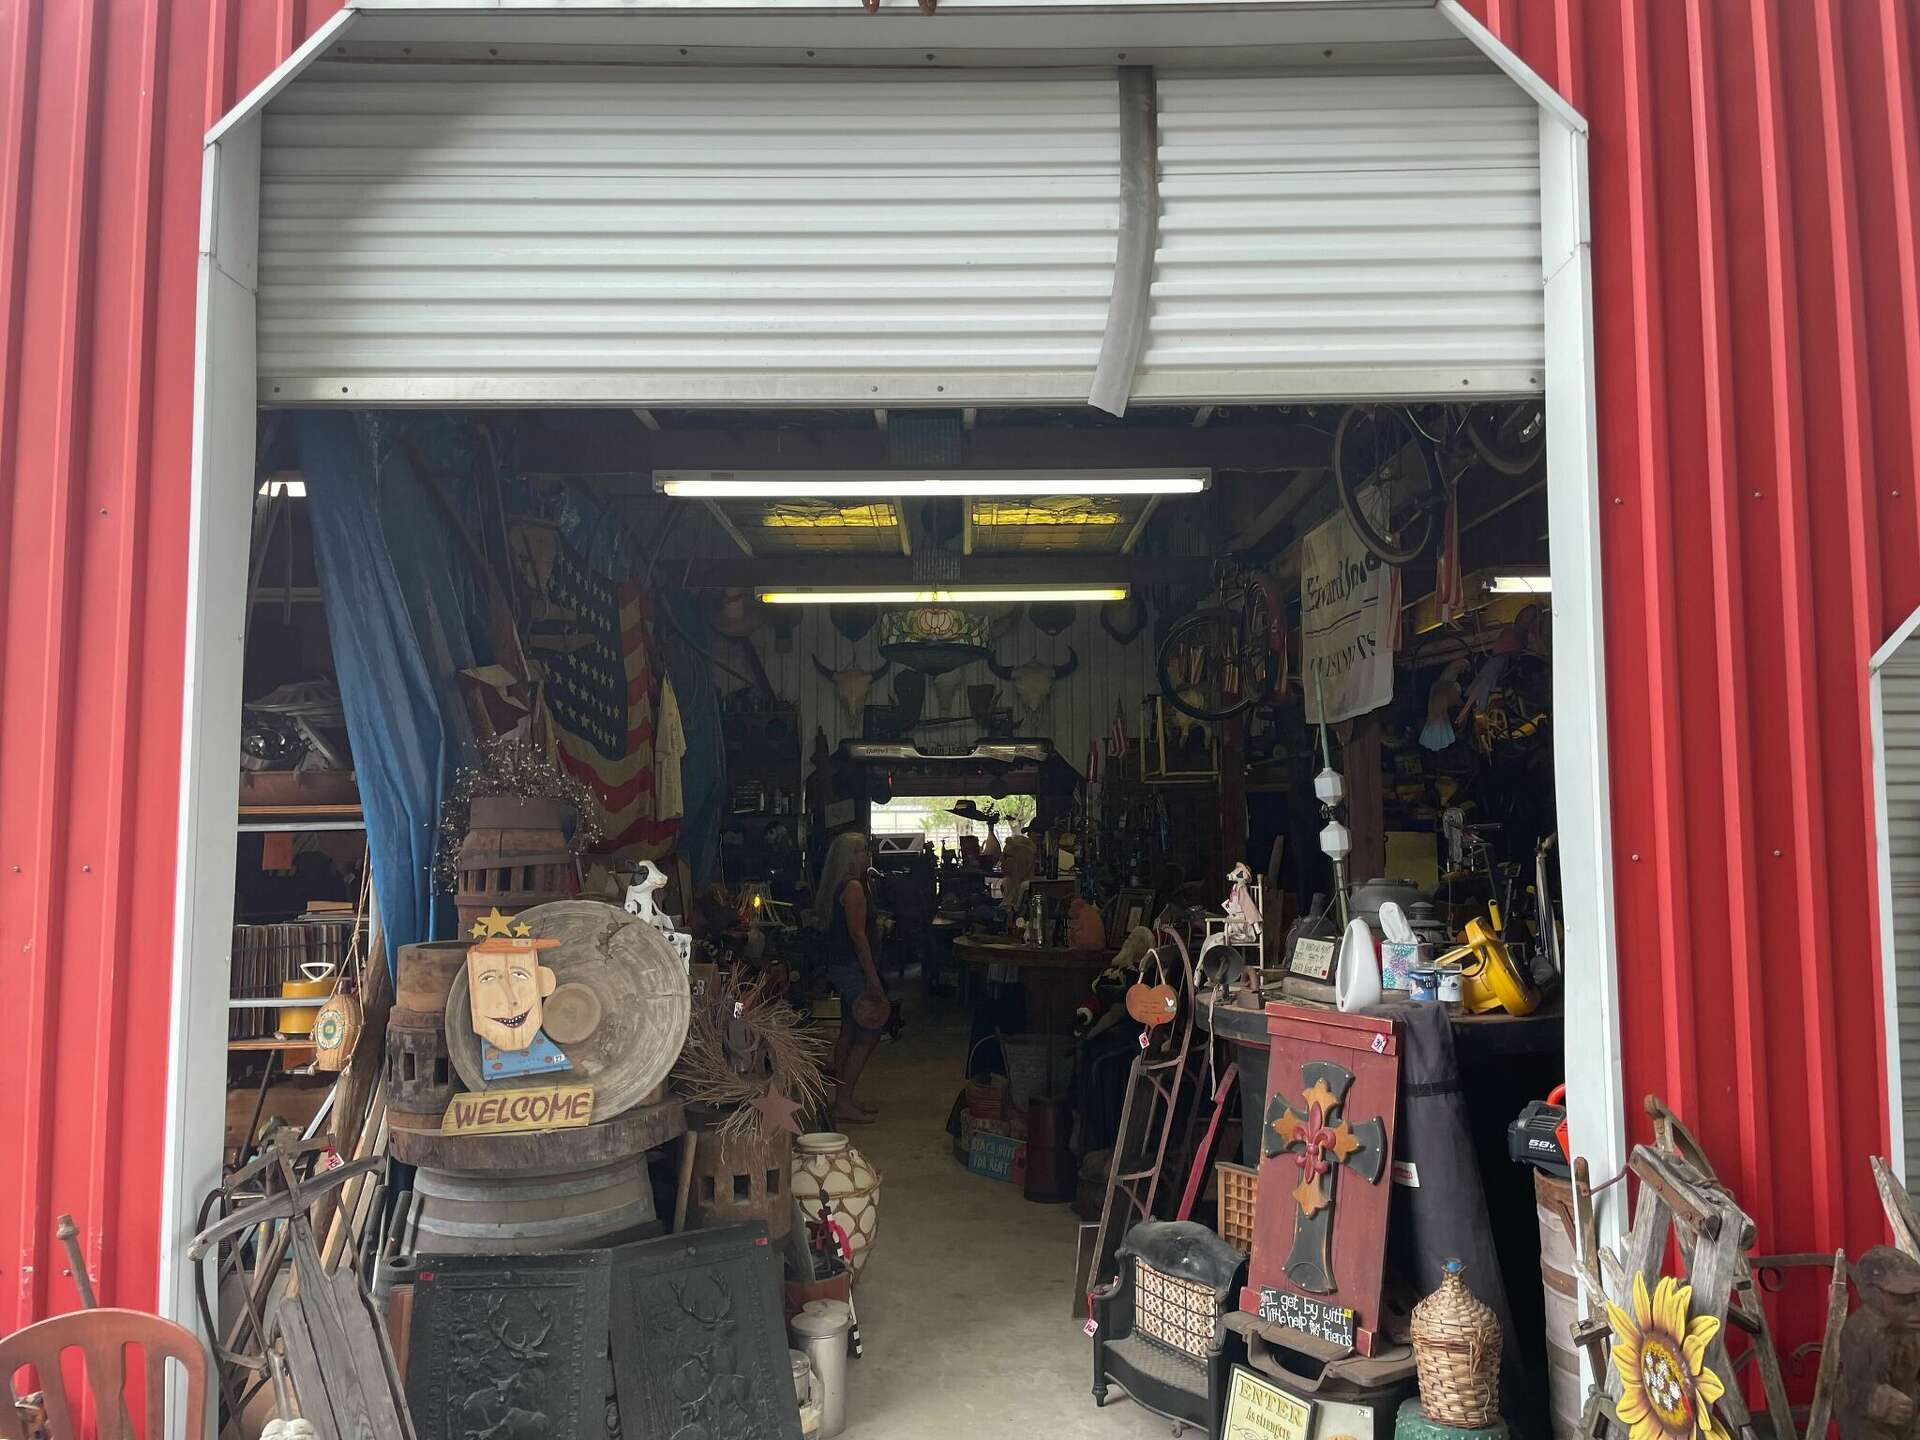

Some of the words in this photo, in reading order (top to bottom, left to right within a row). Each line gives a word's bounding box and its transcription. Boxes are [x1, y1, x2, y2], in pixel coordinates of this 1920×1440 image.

[454, 1092, 591, 1129] WELCOME
[1258, 1308, 1266, 1318] a
[1266, 1305, 1287, 1324] little
[1286, 1311, 1308, 1332] help
[1322, 1320, 1353, 1347] friends
[1265, 1290, 1278, 1306] I
[1280, 1295, 1298, 1311] get
[1304, 1297, 1319, 1321] by
[1322, 1306, 1347, 1326] with
[1239, 1379, 1304, 1427] ENTER
